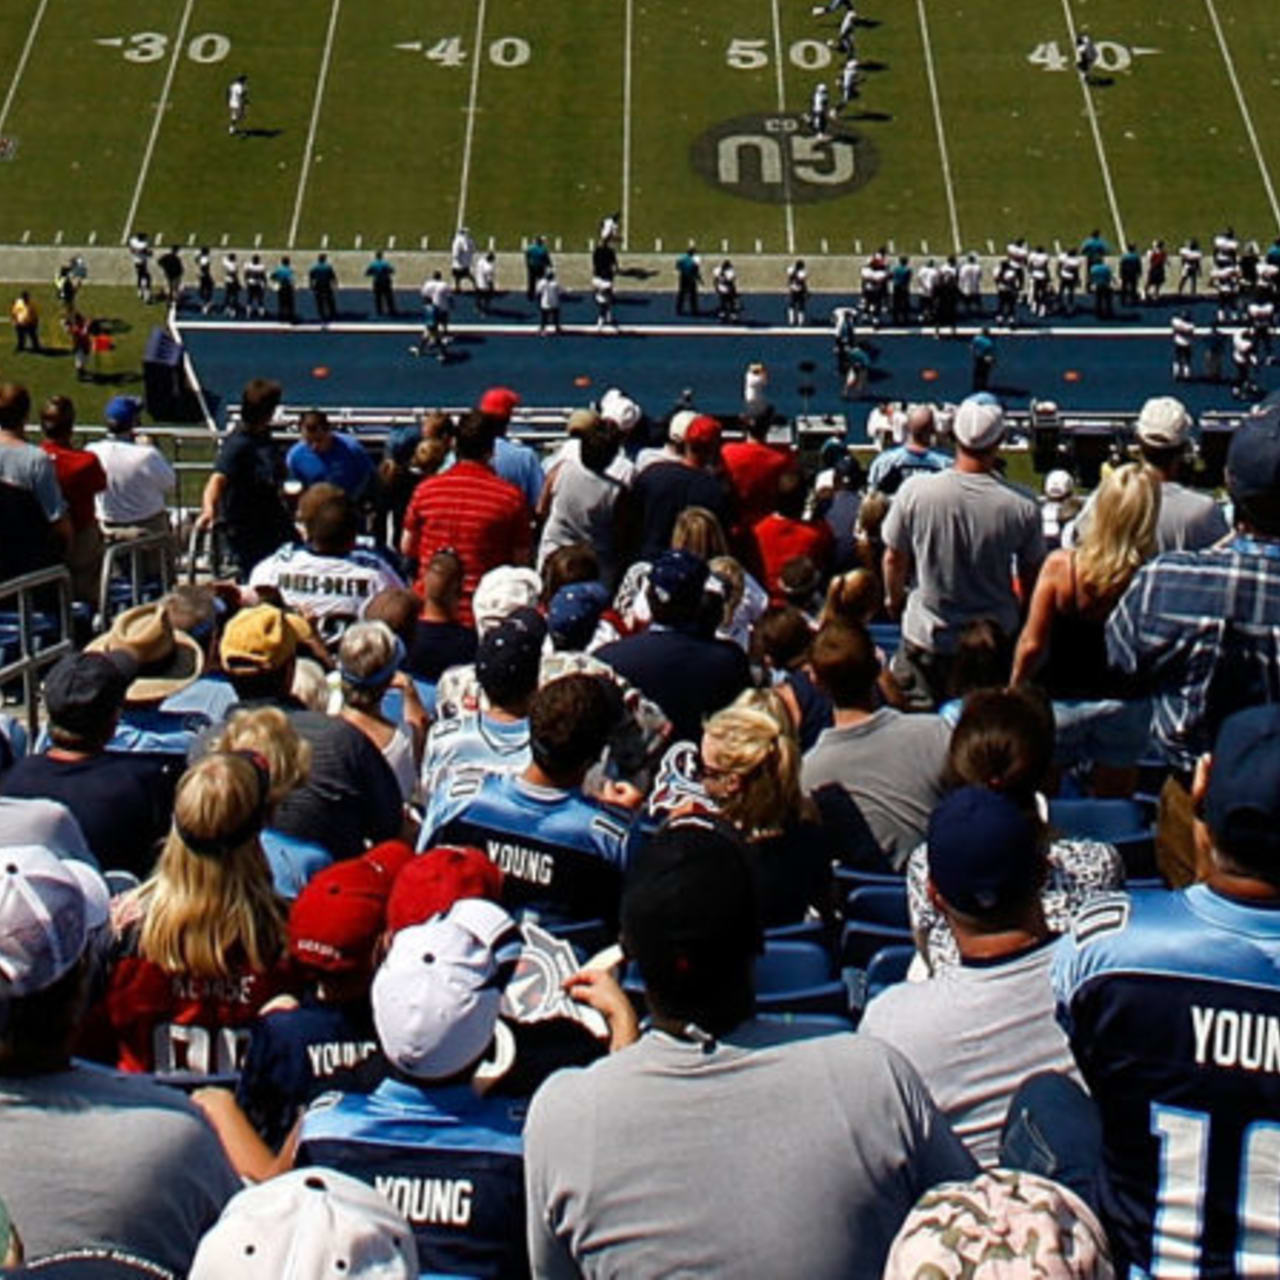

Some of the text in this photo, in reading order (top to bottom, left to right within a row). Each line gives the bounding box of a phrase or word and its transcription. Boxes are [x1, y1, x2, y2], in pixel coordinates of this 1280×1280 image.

[122, 32, 232, 64] 30
[423, 36, 533, 68] 40
[724, 39, 835, 71] 50
[1027, 39, 1134, 72] 40
[277, 572, 370, 599] JONES-DREW
[486, 840, 555, 887] YOUNG
[374, 1174, 476, 1227] YOUNG
